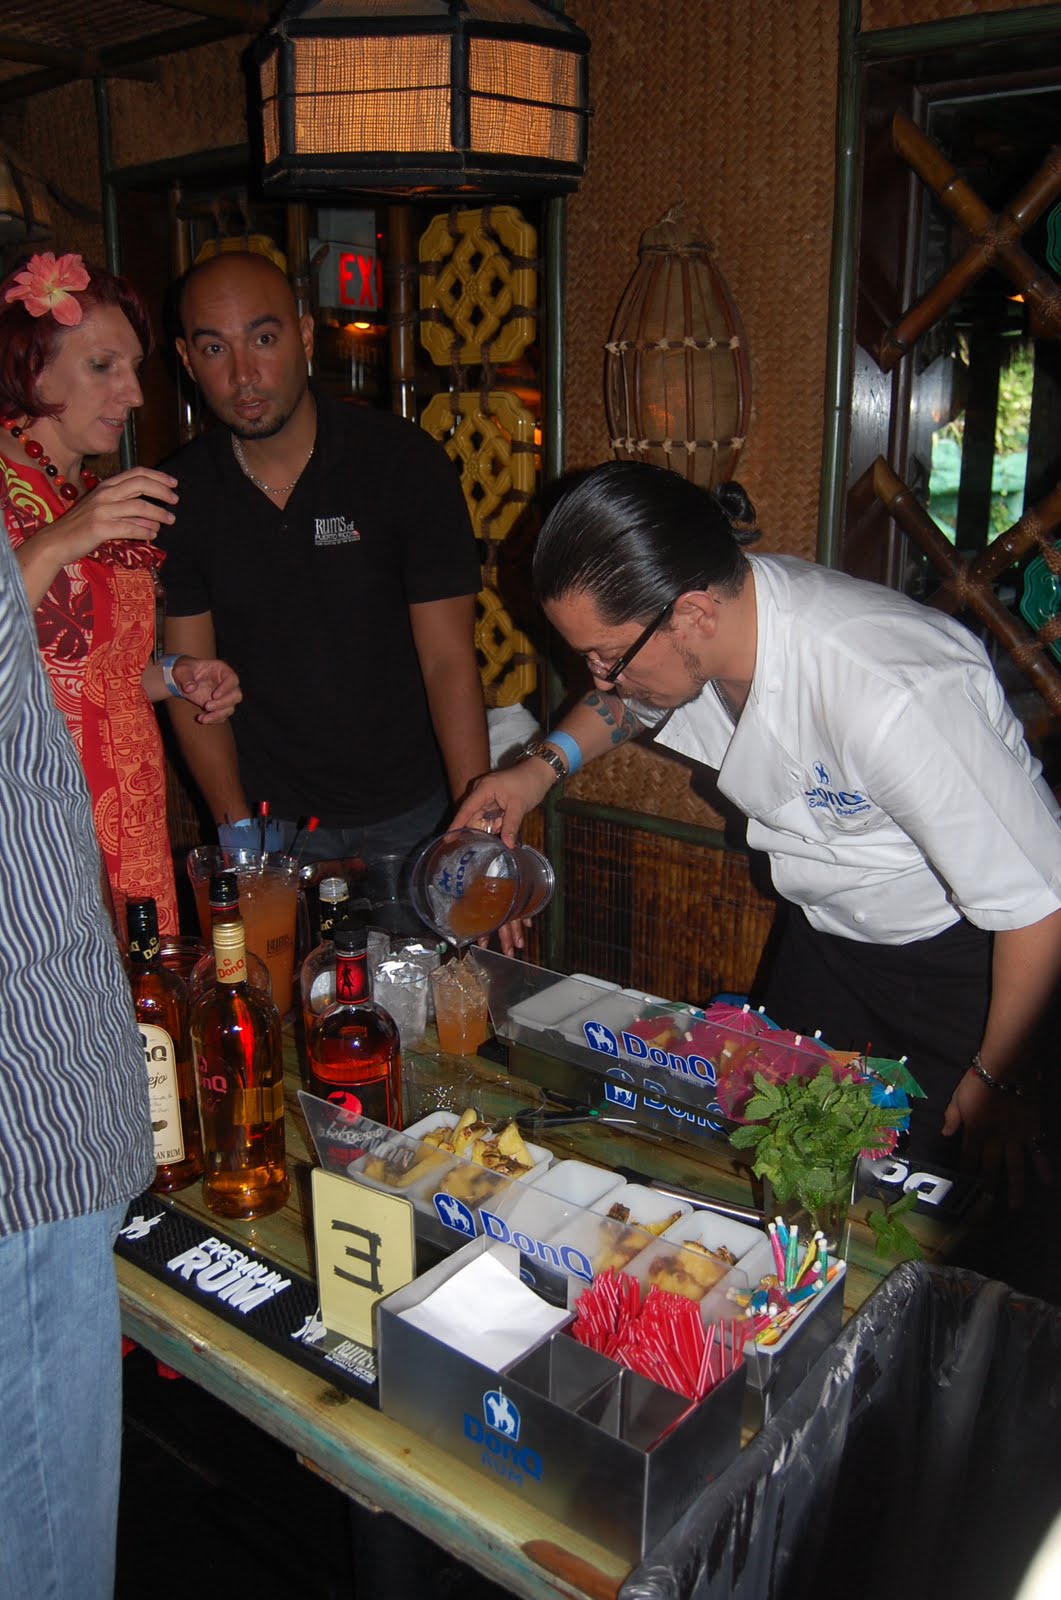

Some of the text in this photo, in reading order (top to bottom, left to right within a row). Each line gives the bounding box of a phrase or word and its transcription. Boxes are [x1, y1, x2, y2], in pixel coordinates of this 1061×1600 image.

[339, 252, 383, 309] EXI
[314, 516, 347, 535] RUMS
[217, 959, 244, 979] DonQ
[621, 1031, 717, 1087] DonQ
[166, 1148, 181, 1159] RUM
[198, 1236, 292, 1294] PREMIUM
[479, 1208, 594, 1283] DonQ
[167, 1247, 275, 1315] RUM
[333, 1340, 375, 1370] RUMS
[464, 1413, 544, 1485] DonQ
